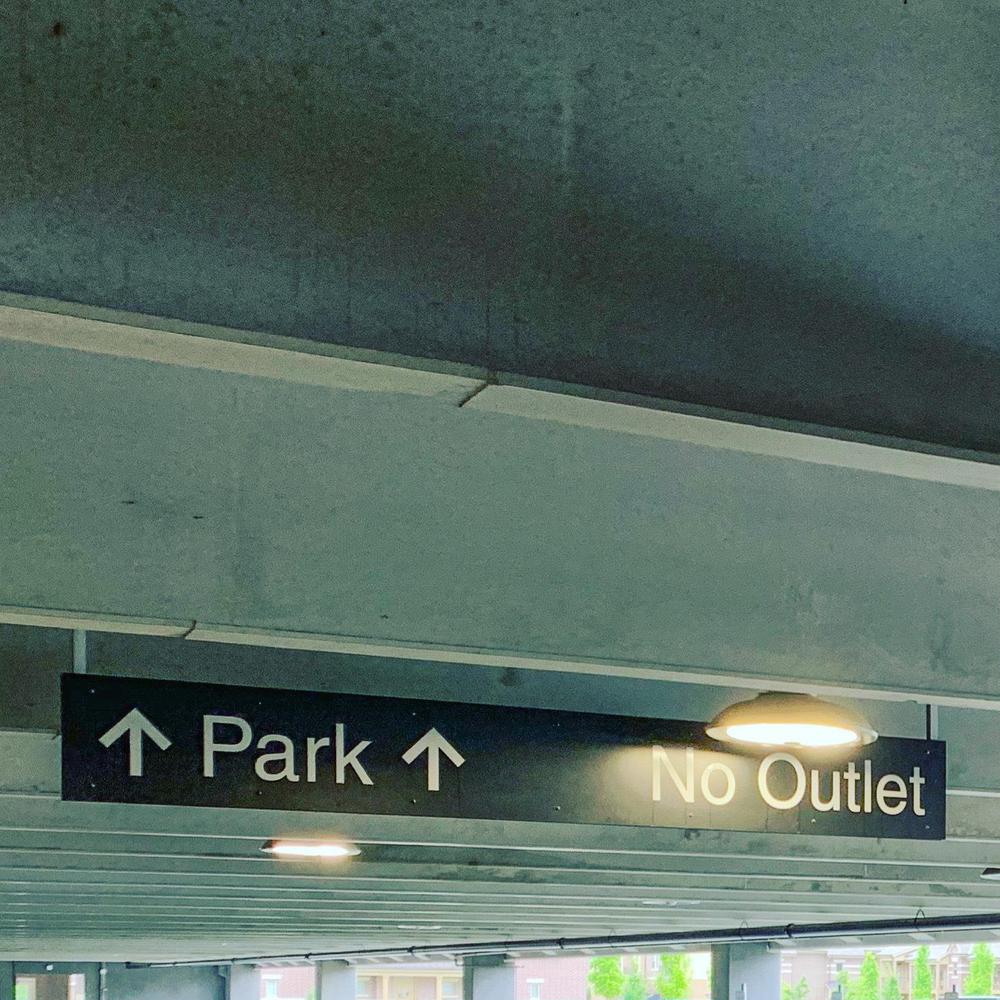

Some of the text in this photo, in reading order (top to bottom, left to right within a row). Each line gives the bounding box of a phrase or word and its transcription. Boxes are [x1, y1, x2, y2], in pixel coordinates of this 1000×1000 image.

[202, 713, 375, 786] Park
[651, 744, 926, 816] No Outlet
